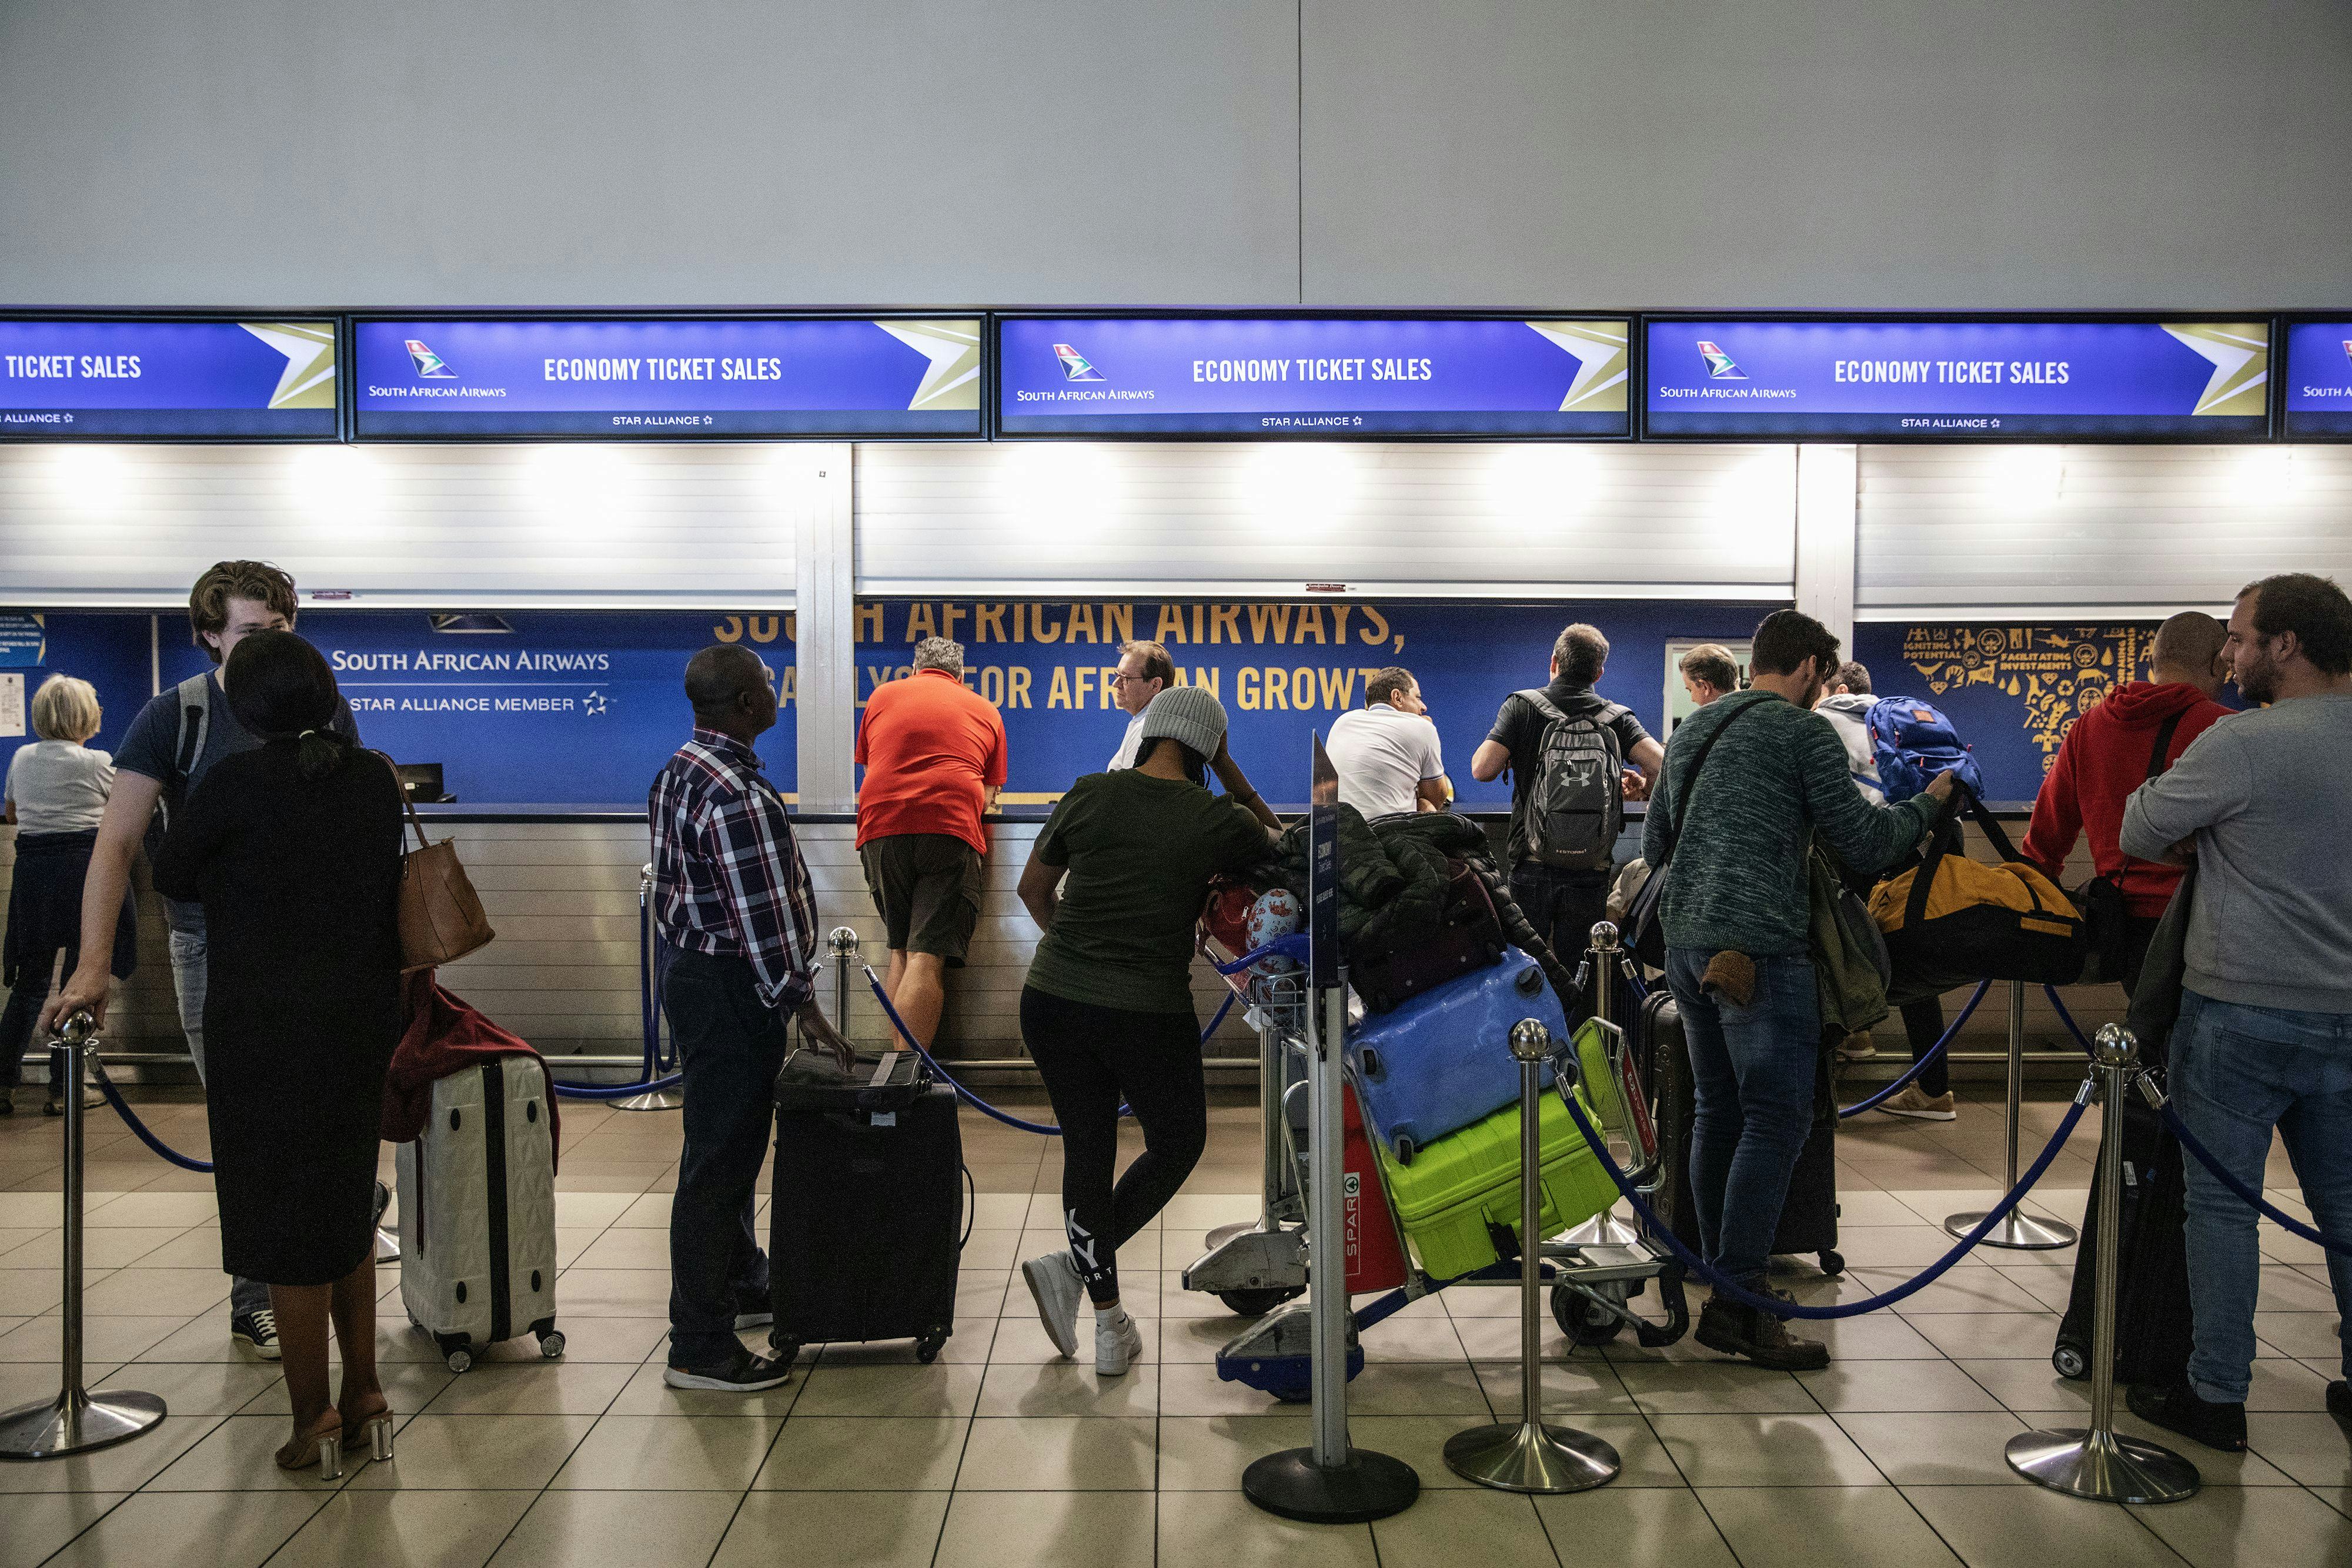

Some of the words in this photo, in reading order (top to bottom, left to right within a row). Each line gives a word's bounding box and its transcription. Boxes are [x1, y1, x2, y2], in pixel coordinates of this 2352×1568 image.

[5, 355, 75, 378] TICKET
[81, 355, 142, 378] SALES
[544, 358, 641, 381] ECONOMY
[646, 358, 716, 380] TICKET
[721, 357, 781, 380] SALES
[1192, 359, 1291, 382] ECONOMY
[1296, 359, 1365, 381] TICKET
[1371, 358, 1432, 380] SALES
[1835, 360, 1931, 383] ECONOMY
[1936, 361, 2004, 383] TICKET
[2009, 361, 2070, 384] SALES
[369, 385, 407, 397] SOUTH
[409, 386, 457, 397] AFRICAN
[459, 386, 507, 398] AIRWAYS
[1017, 390, 1055, 402] SOUTH
[1057, 389, 1106, 401] AFRICAN
[1108, 389, 1155, 400] AIRWAYS
[1660, 386, 1698, 398] SOUTH
[1700, 387, 1748, 399] AFRICAN
[1750, 387, 1797, 399] AIRWAYS
[2303, 386, 2342, 397] SOUTH
[4, 413, 61, 423] ALLIANCE
[612, 416, 642, 425] STAR
[644, 416, 700, 425] ALLIANCE
[1261, 417, 1291, 427] STAR
[1293, 416, 1349, 426] ALLIANCE
[1901, 418, 1930, 427] STAR
[1932, 418, 1988, 428] ALLIANCE
[906, 603, 1133, 644] AFRICAN
[1154, 603, 1404, 654] AIRWAYS,
[332, 650, 407, 671] SOUTH
[413, 650, 510, 672] AFRICAN
[514, 650, 610, 672] AIRWAYS
[1903, 651, 1962, 659] POTENTIAL
[2117, 639, 2126, 684] ORMING
[1047, 666, 1219, 710] AFRN
[1237, 666, 1380, 710] GROWT
[350, 697, 395, 711] STAR
[400, 698, 490, 711] ALLIANCE
[495, 698, 574, 711] MEMBER
[1347, 1198, 1357, 1256] SPAR
